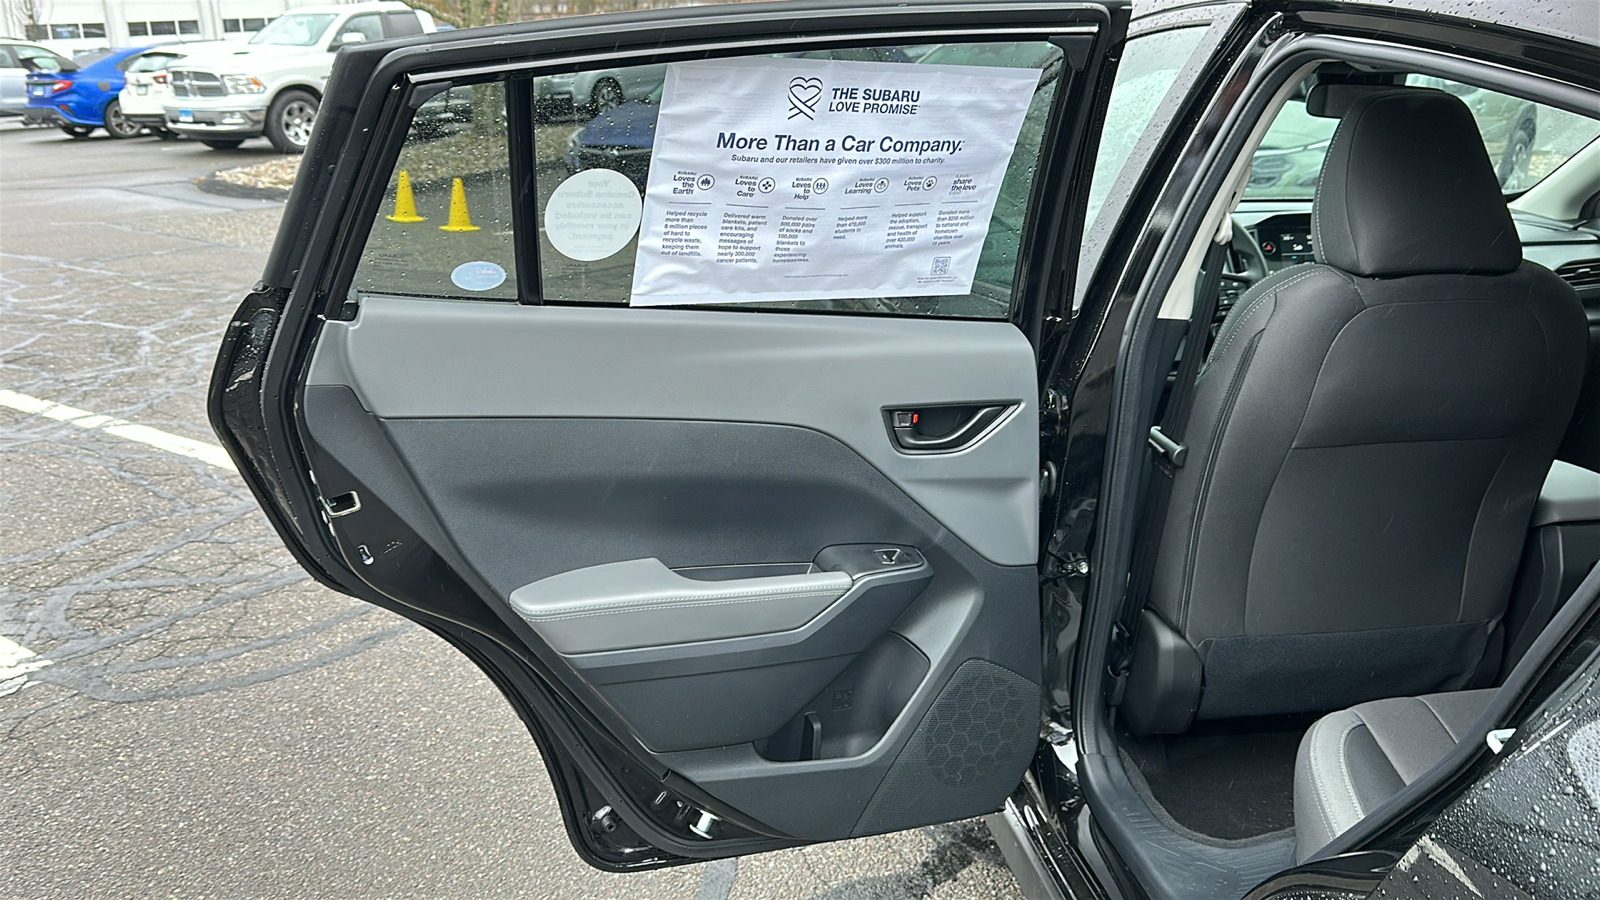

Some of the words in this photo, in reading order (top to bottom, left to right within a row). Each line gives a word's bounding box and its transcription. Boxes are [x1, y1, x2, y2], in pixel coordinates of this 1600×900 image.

[832, 88, 858, 100] THE
[862, 88, 920, 102] SUBARU
[828, 101, 860, 112] LOVE
[862, 102, 919, 115] PROMISE
[716, 132, 767, 150] More
[774, 135, 819, 151] Than
[825, 138, 836, 152] a
[842, 135, 874, 152] Car
[731, 154, 758, 163] Subaru
[789, 156, 818, 164] retailers
[820, 156, 836, 164] have
[837, 156, 857, 166] given
[874, 156, 890, 165] $300
[892, 156, 914, 164] million
[922, 156, 945, 166] charity.
